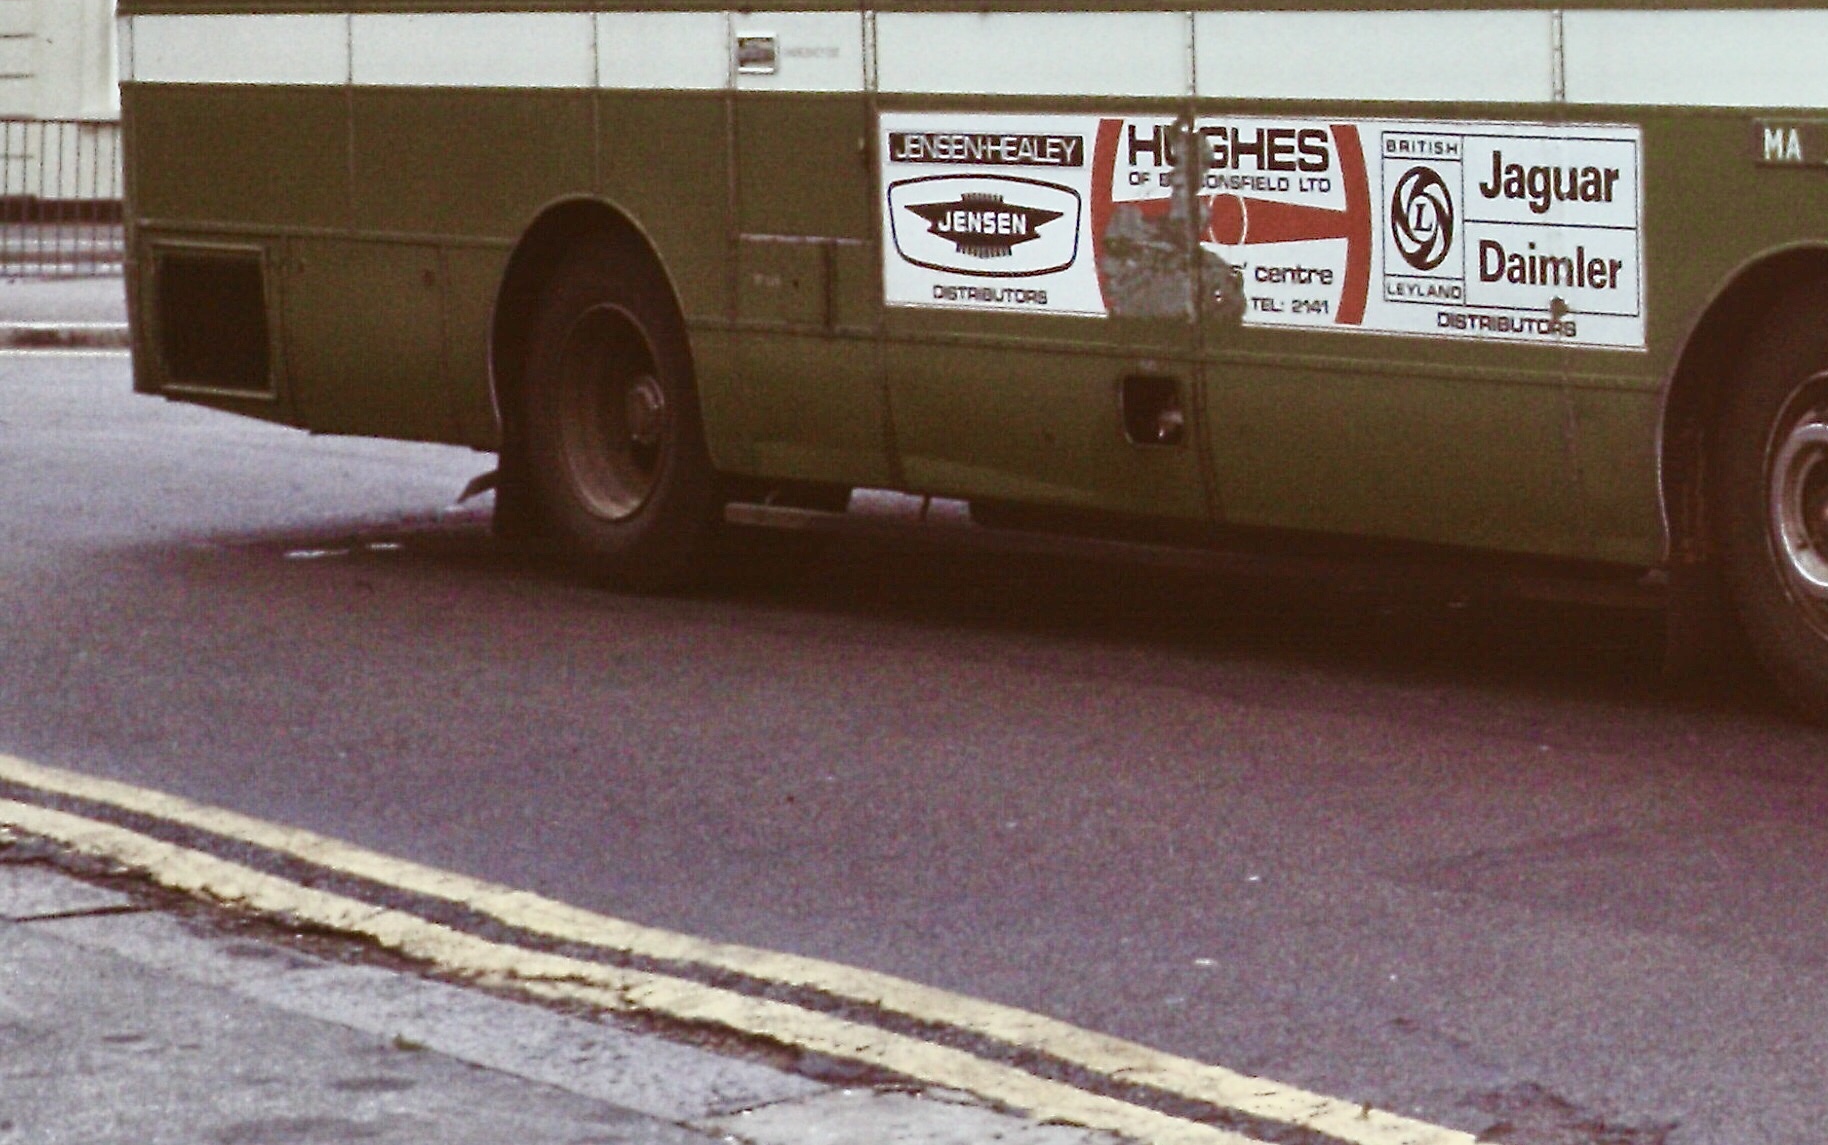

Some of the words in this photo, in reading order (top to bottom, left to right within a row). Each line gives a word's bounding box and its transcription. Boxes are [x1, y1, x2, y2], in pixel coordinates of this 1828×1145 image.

[1386, 140, 1459, 155] BRITISH
[1764, 128, 1803, 161] MA
[1128, 171, 1151, 187] OF
[1298, 177, 1331, 194] LTD
[1479, 150, 1620, 214] Jaguar
[937, 210, 1027, 236] JENSEN
[1413, 203, 1433, 232] L
[1254, 265, 1334, 286] centre
[1479, 239, 1622, 290] Daimler
[932, 285, 1048, 306] DISTRIBUTORS
[1387, 282, 1463, 299] LEYLAND
[1291, 299, 1330, 315] 2141
[1437, 312, 1577, 338] DISTRIBUTORS
